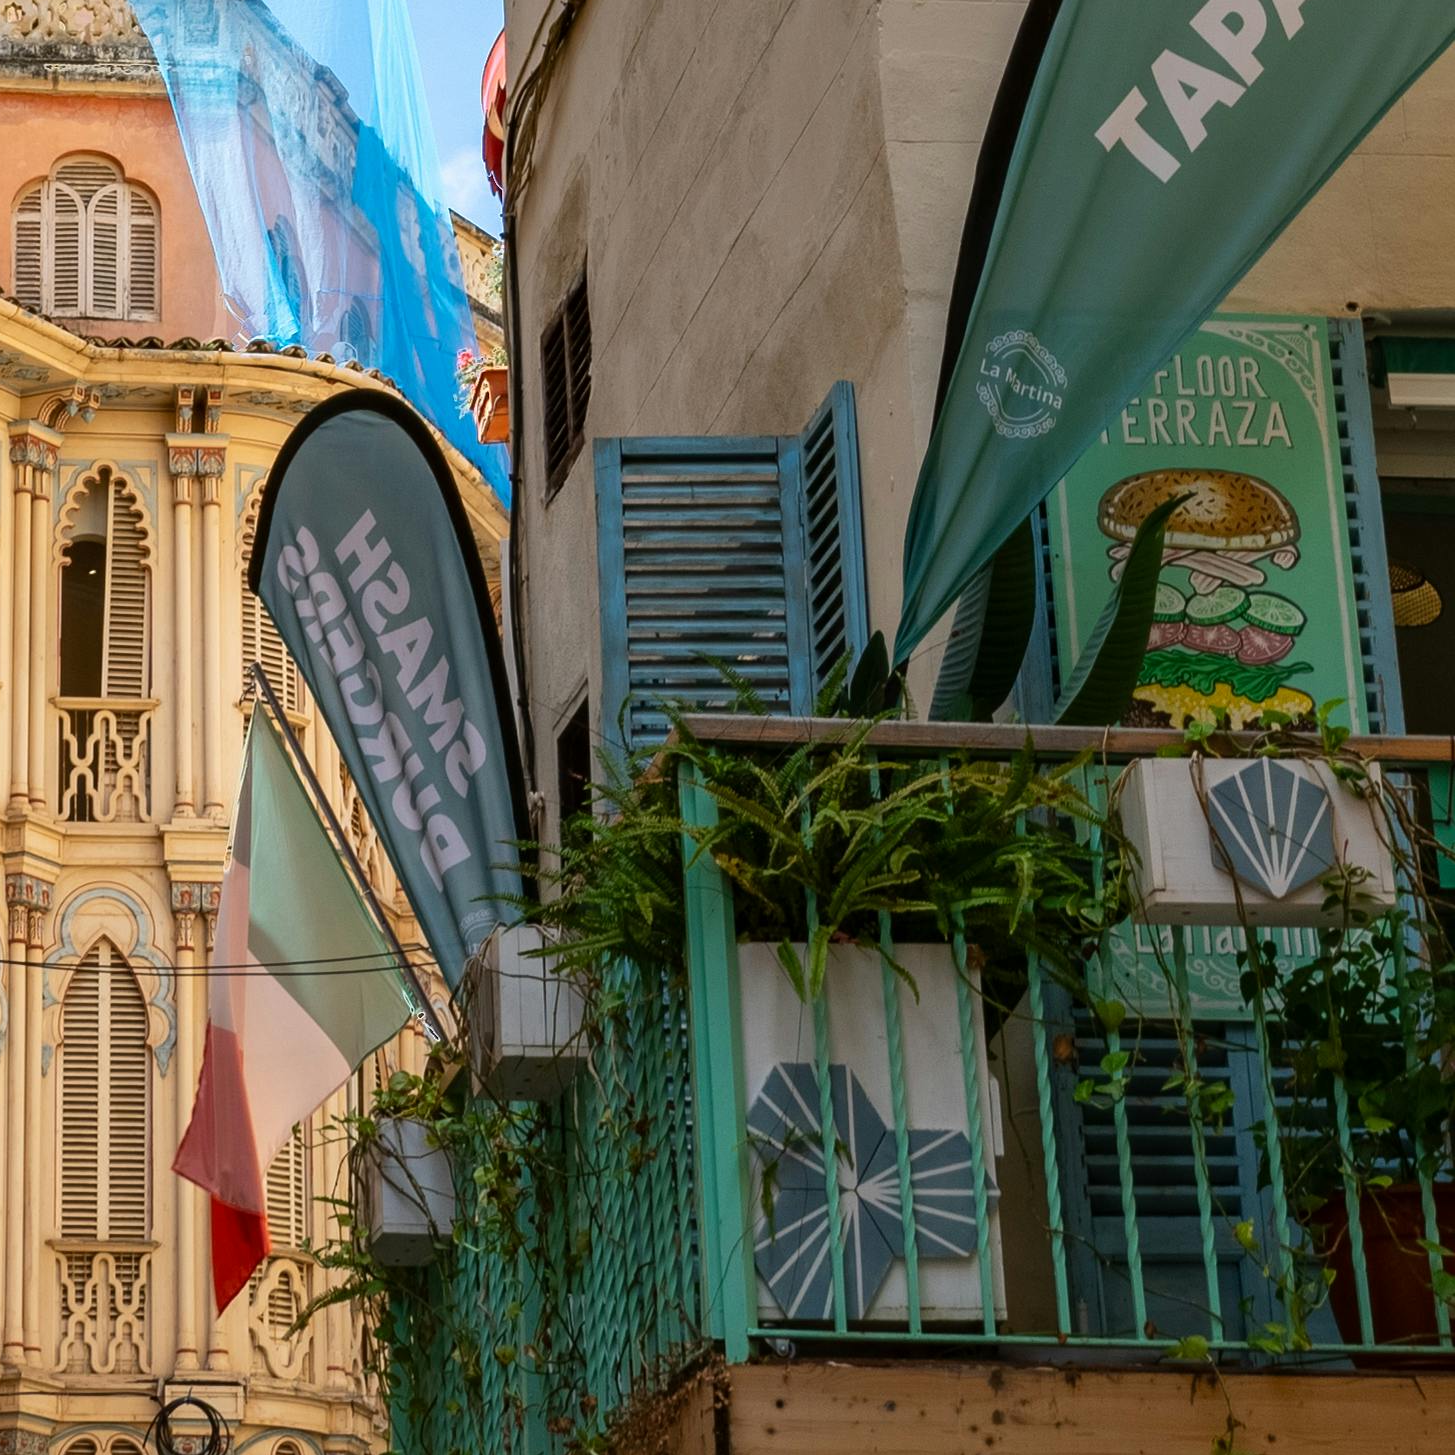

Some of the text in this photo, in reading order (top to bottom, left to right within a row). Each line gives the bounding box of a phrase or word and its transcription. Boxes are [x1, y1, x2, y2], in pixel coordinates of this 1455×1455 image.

[979, 356, 1064, 412] La Martina
[1100, 397, 1294, 448] ERRAZA
